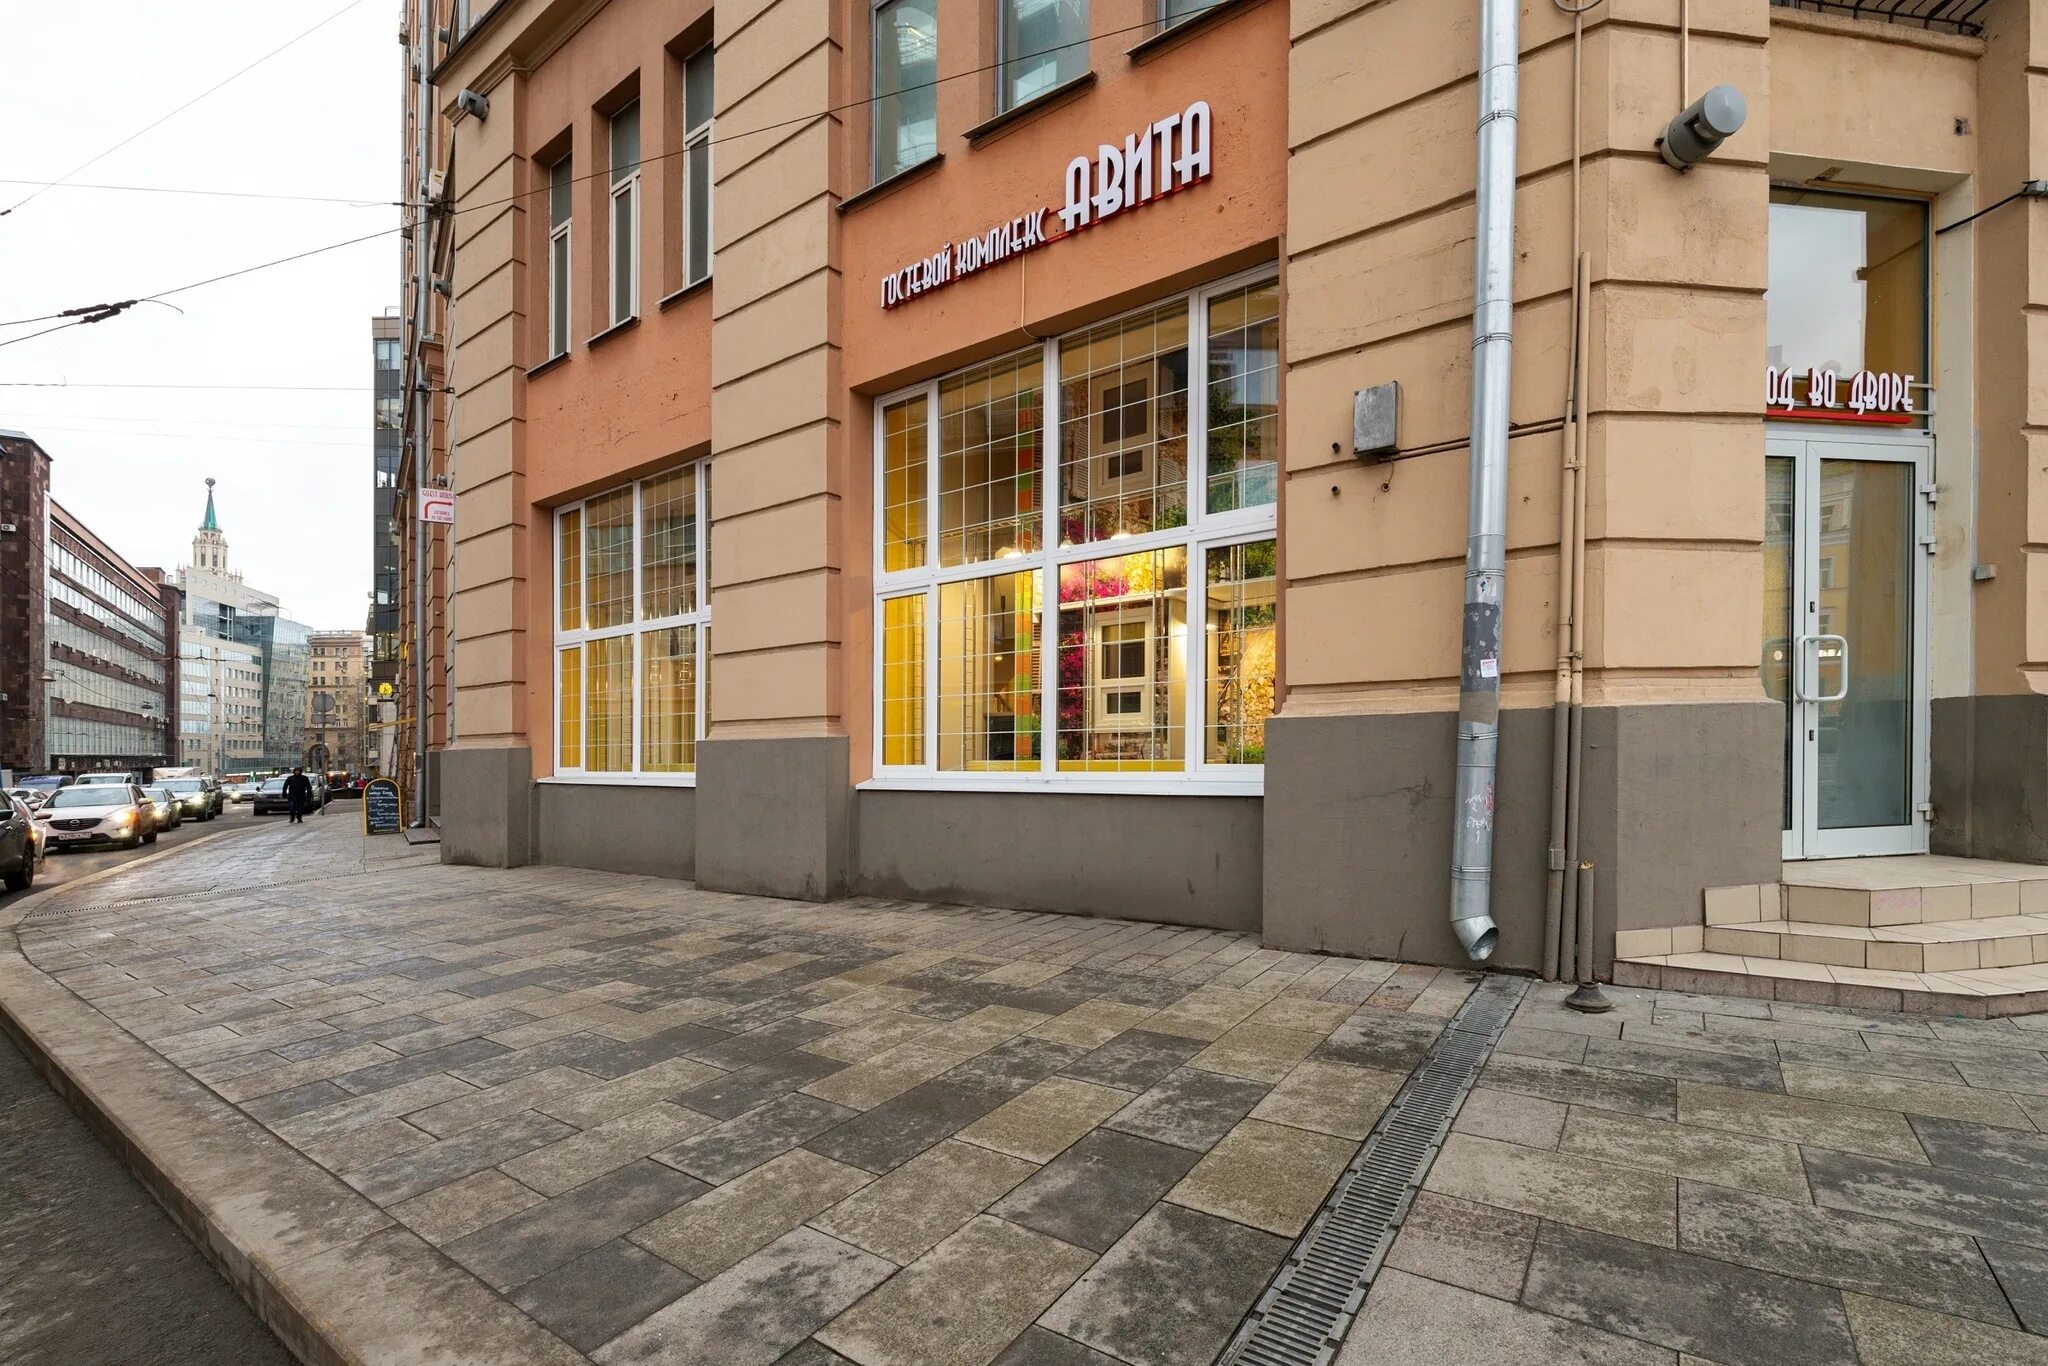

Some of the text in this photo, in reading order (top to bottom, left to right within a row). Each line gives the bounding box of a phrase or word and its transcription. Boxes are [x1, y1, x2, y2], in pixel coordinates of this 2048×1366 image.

[880, 100, 1213, 309] ГОСТЕВОЙ КОМПЛЕКС АВИТА
[1808, 367, 1836, 408] ВО
[1848, 370, 1915, 415] ДВОРЕ
